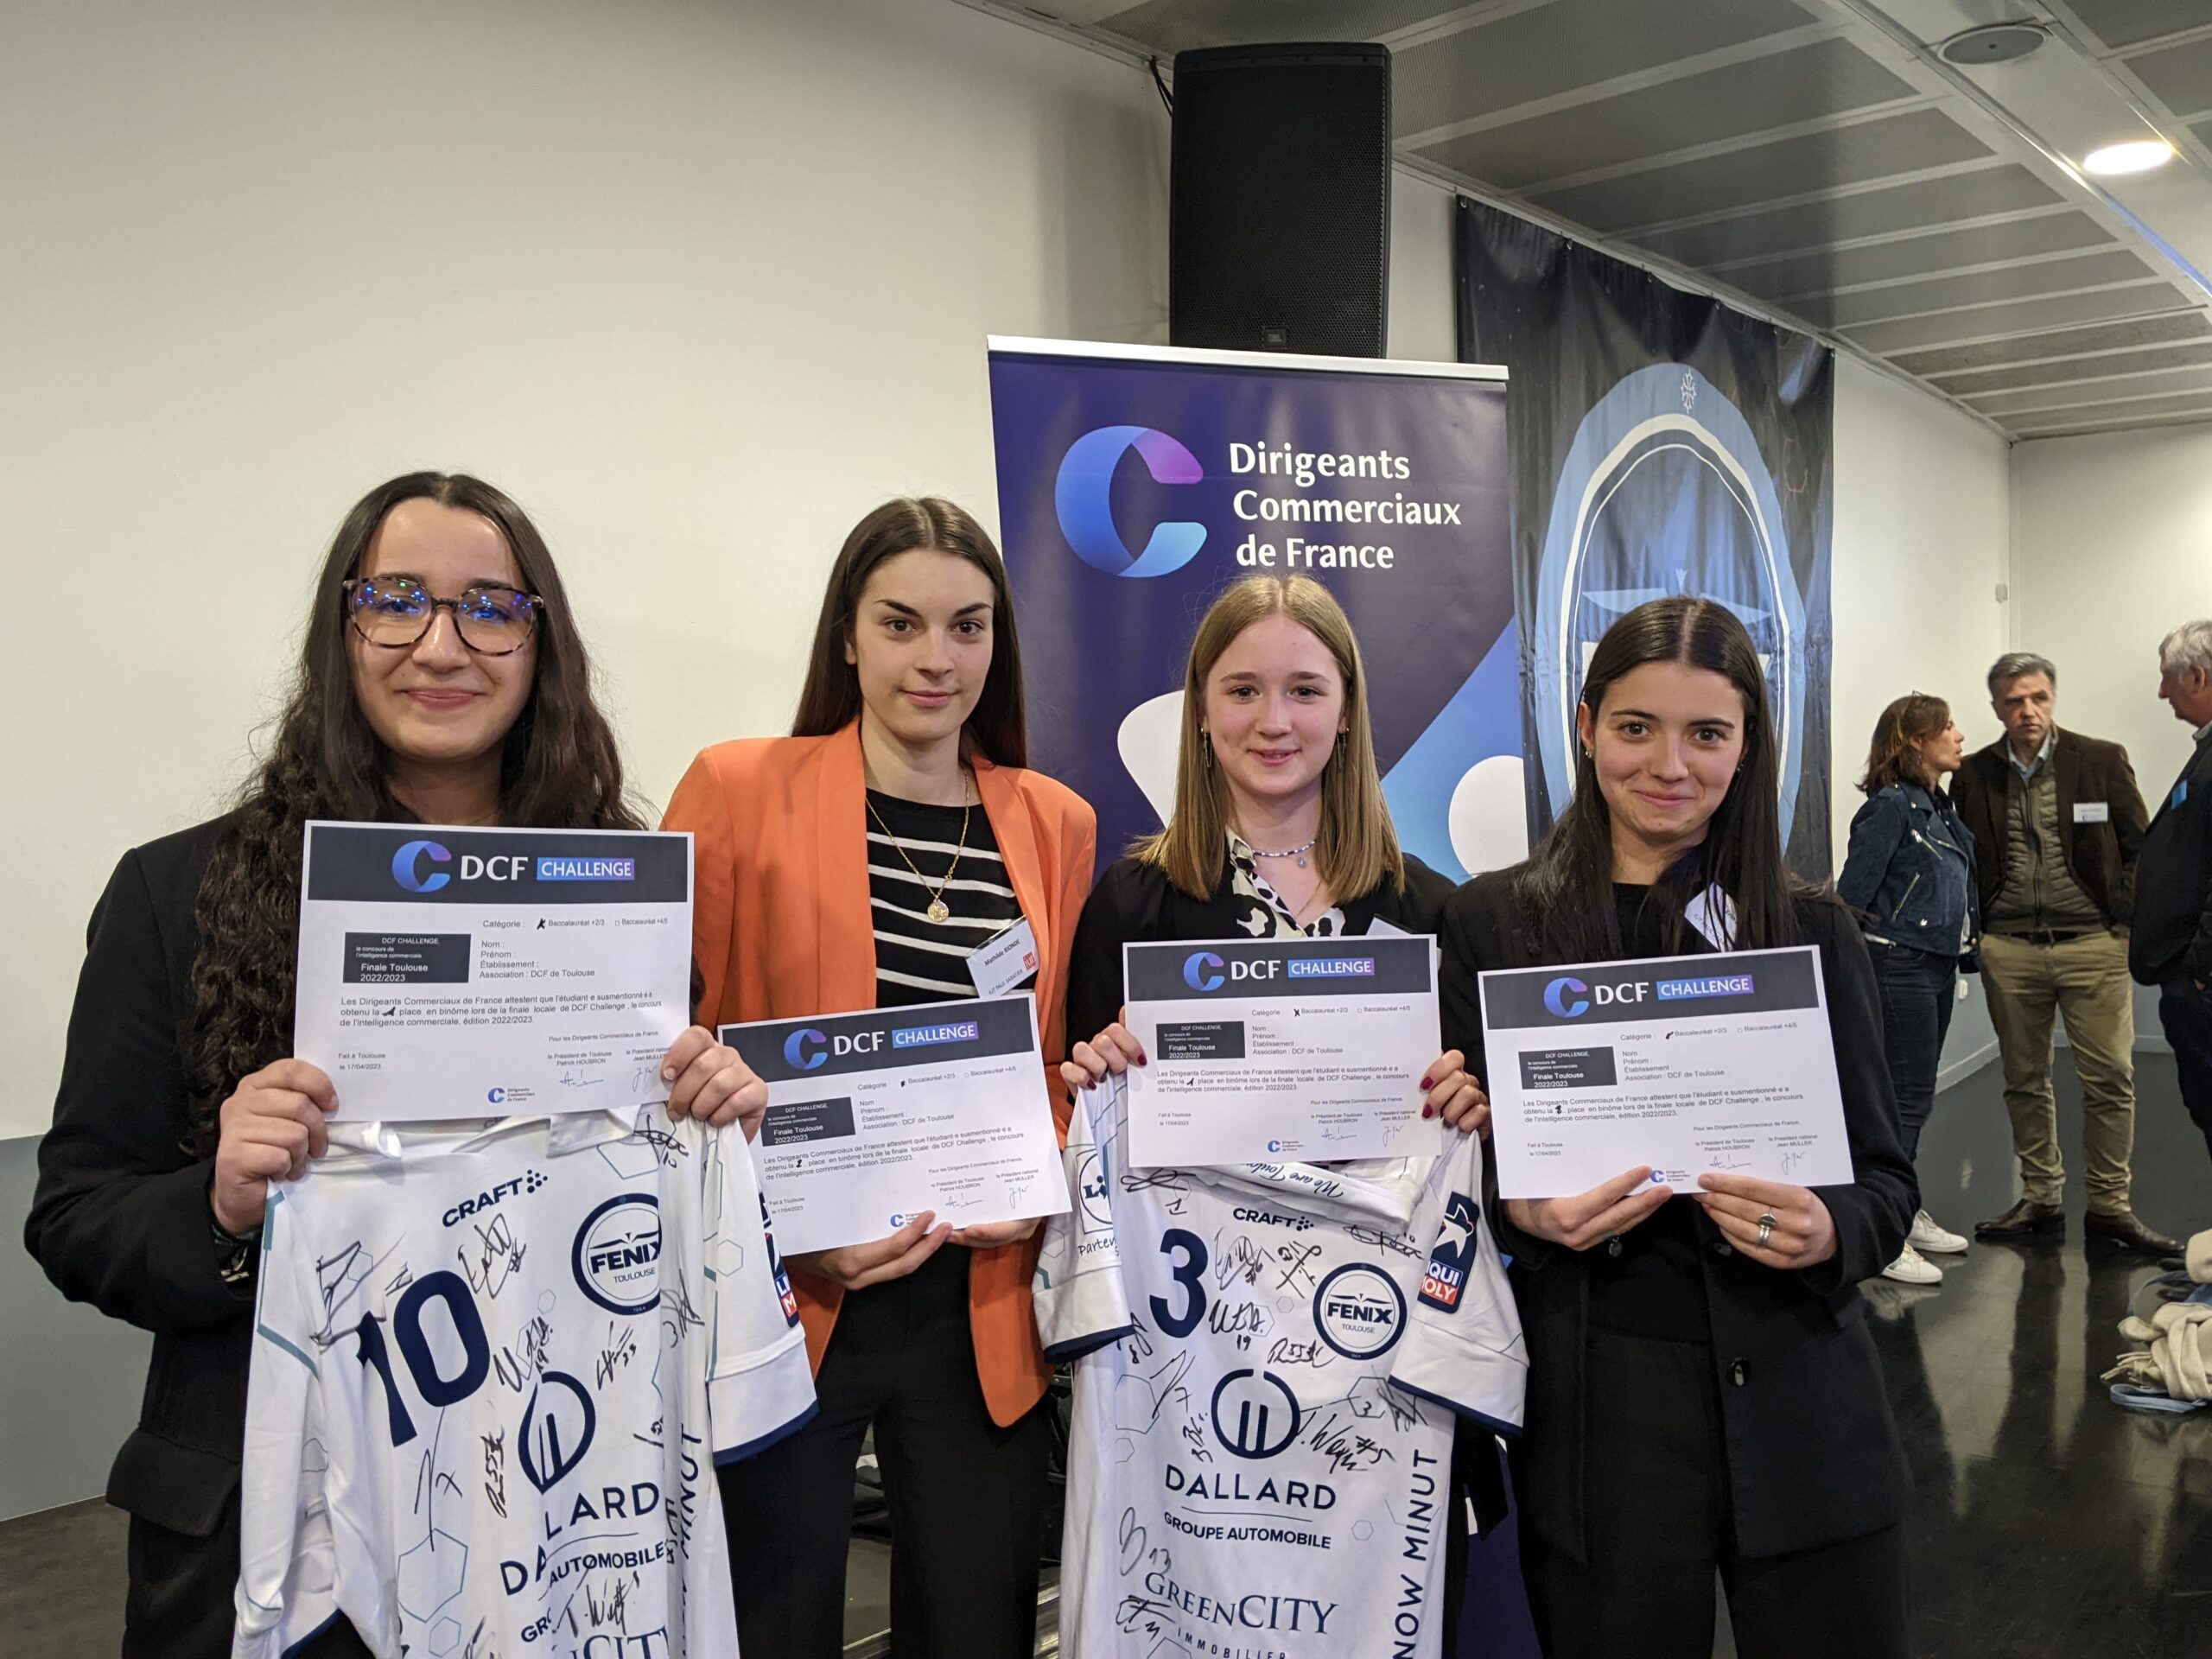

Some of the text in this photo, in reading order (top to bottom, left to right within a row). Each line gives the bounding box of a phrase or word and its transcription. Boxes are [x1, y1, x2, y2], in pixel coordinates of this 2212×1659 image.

[1230, 441, 1410, 487] Dirigeants
[1233, 489, 1461, 524] Commerciaux
[1236, 534, 1394, 569] de France
[460, 855, 631, 880] DCF CHALLENGE
[482, 918, 520, 930] Catégorie
[480, 949, 512, 958] Prénom
[360, 973, 404, 982] 2022/2023
[390, 963, 428, 971] Toulouse
[530, 969, 548, 978] DCF
[561, 968, 594, 977] Toulouse
[1230, 959, 1371, 980] DCF CHALLENGE
[340, 996, 357, 1006] Les
[359, 996, 402, 1007] Dirigeants
[404, 995, 461, 1005] Commerciaux
[474, 995, 502, 1004] France
[504, 995, 537, 1003] attestent
[539, 995, 553, 1004] que
[555, 993, 589, 1002] l'étudiant
[596, 990, 643, 1001] susmentionné
[1594, 977, 1750, 1004] DCF CHALLENGE
[340, 1007, 370, 1016] obtenu
[372, 1007, 379, 1016] la
[398, 1007, 422, 1017] place
[439, 1007, 468, 1015] binôme
[470, 1006, 485, 1016] lors
[486, 1006, 498, 1014] de
[508, 1005, 529, 1014] finale
[533, 1003, 556, 1013] locale
[570, 1002, 588, 1014] DCF
[589, 1002, 625, 1011] Challenge
[631, 1001, 638, 1010] le
[339, 1018, 351, 1027] de
[353, 1016, 404, 1028] l'intelligence
[462, 1016, 489, 1025] édition
[833, 1024, 975, 1055] DCF CHALLENGE
[860, 1106, 885, 1115] Prénom
[862, 1121, 898, 1130] Association
[901, 1116, 916, 1125] DCF
[774, 1134, 808, 1143] 2022/2023
[442, 1178, 523, 1227] CRAFT
[1233, 1208, 1296, 1228] CRAFT
[613, 1268, 656, 1284] TOULOUSE
[1149, 1228, 1208, 1338] 3
[1327, 1301, 1395, 1325] FENIX
[1342, 1323, 1376, 1334] TOULOUSE
[356, 1270, 490, 1447] 10
[1165, 1464, 1336, 1510] DALLARD
[1402, 1449, 1438, 1560] MINUT
[1164, 1512, 1332, 1549] GROUPE AUTOMOBILE
[550, 1541, 664, 1588] AUTOMOBILE
